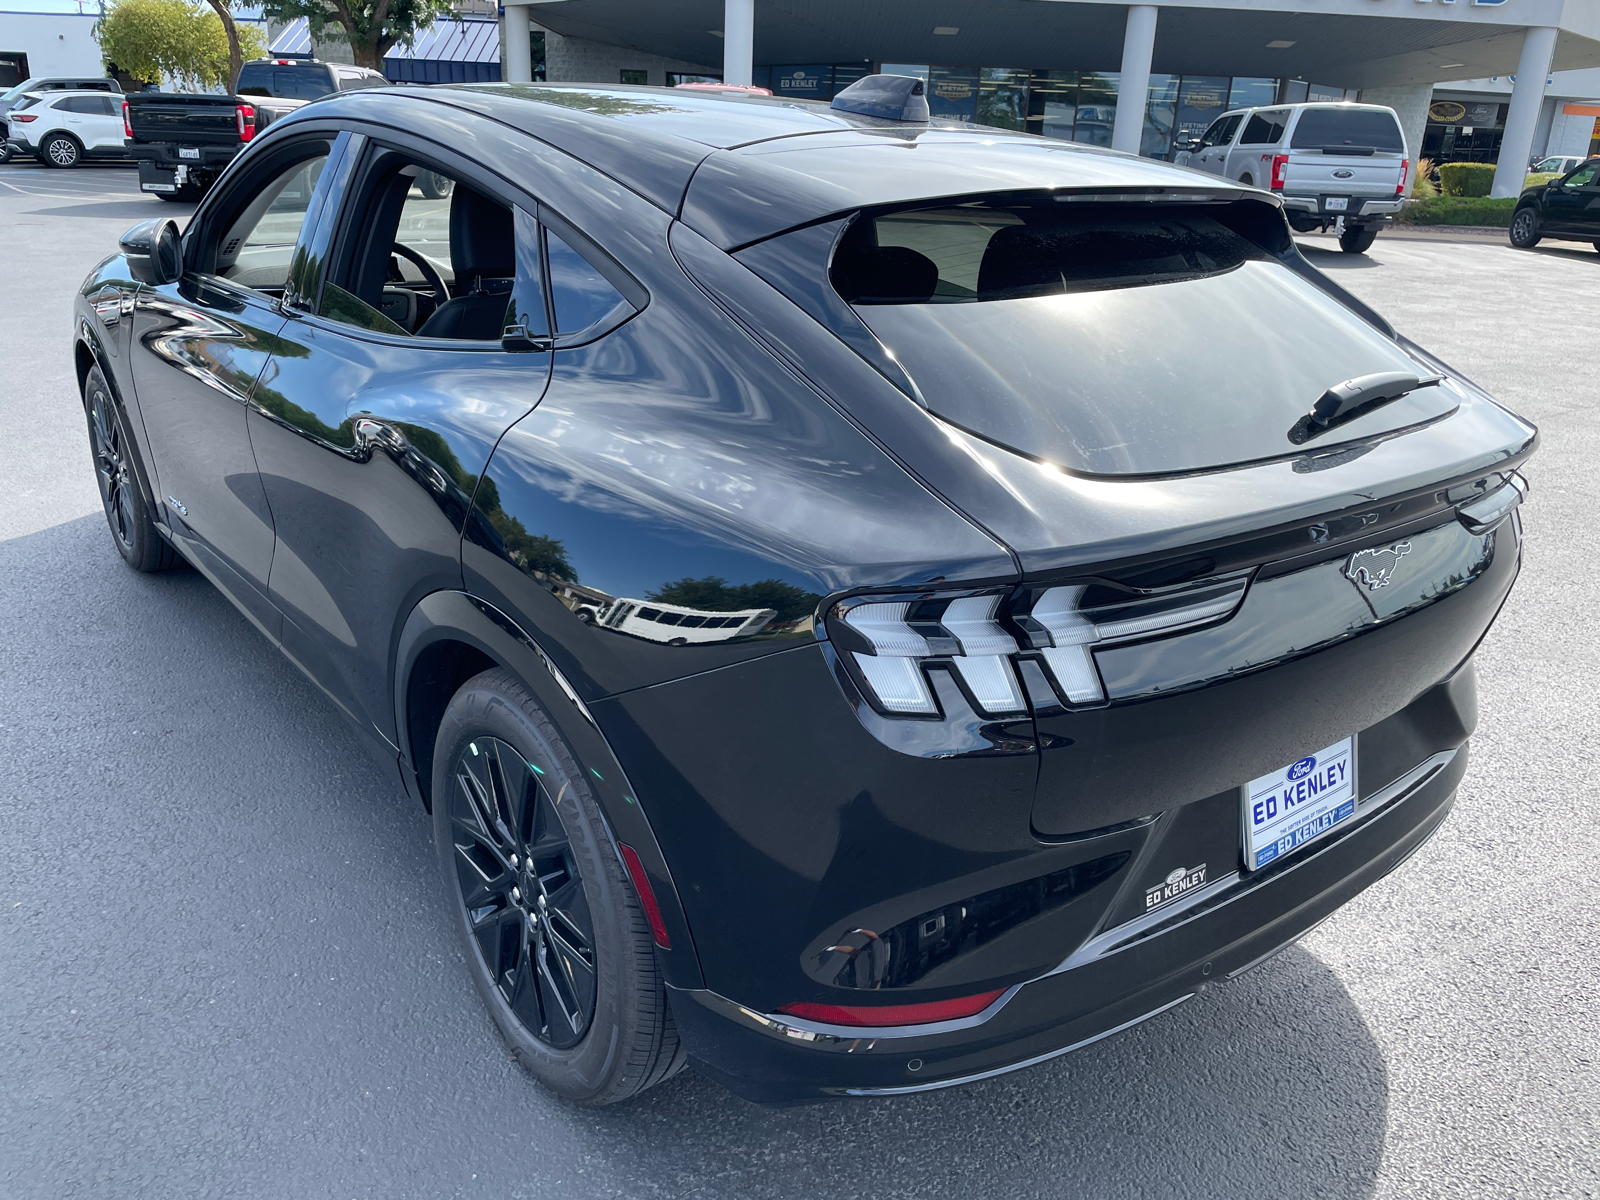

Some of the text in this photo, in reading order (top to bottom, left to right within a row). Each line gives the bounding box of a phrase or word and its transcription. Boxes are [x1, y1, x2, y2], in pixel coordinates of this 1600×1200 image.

[780, 79, 818, 88] ED KENLEY
[1292, 760, 1312, 779] Ford
[1253, 758, 1347, 826] ED KENLEY
[1277, 810, 1336, 855] ED KENLEY
[1146, 869, 1206, 907] ED KENLEY
